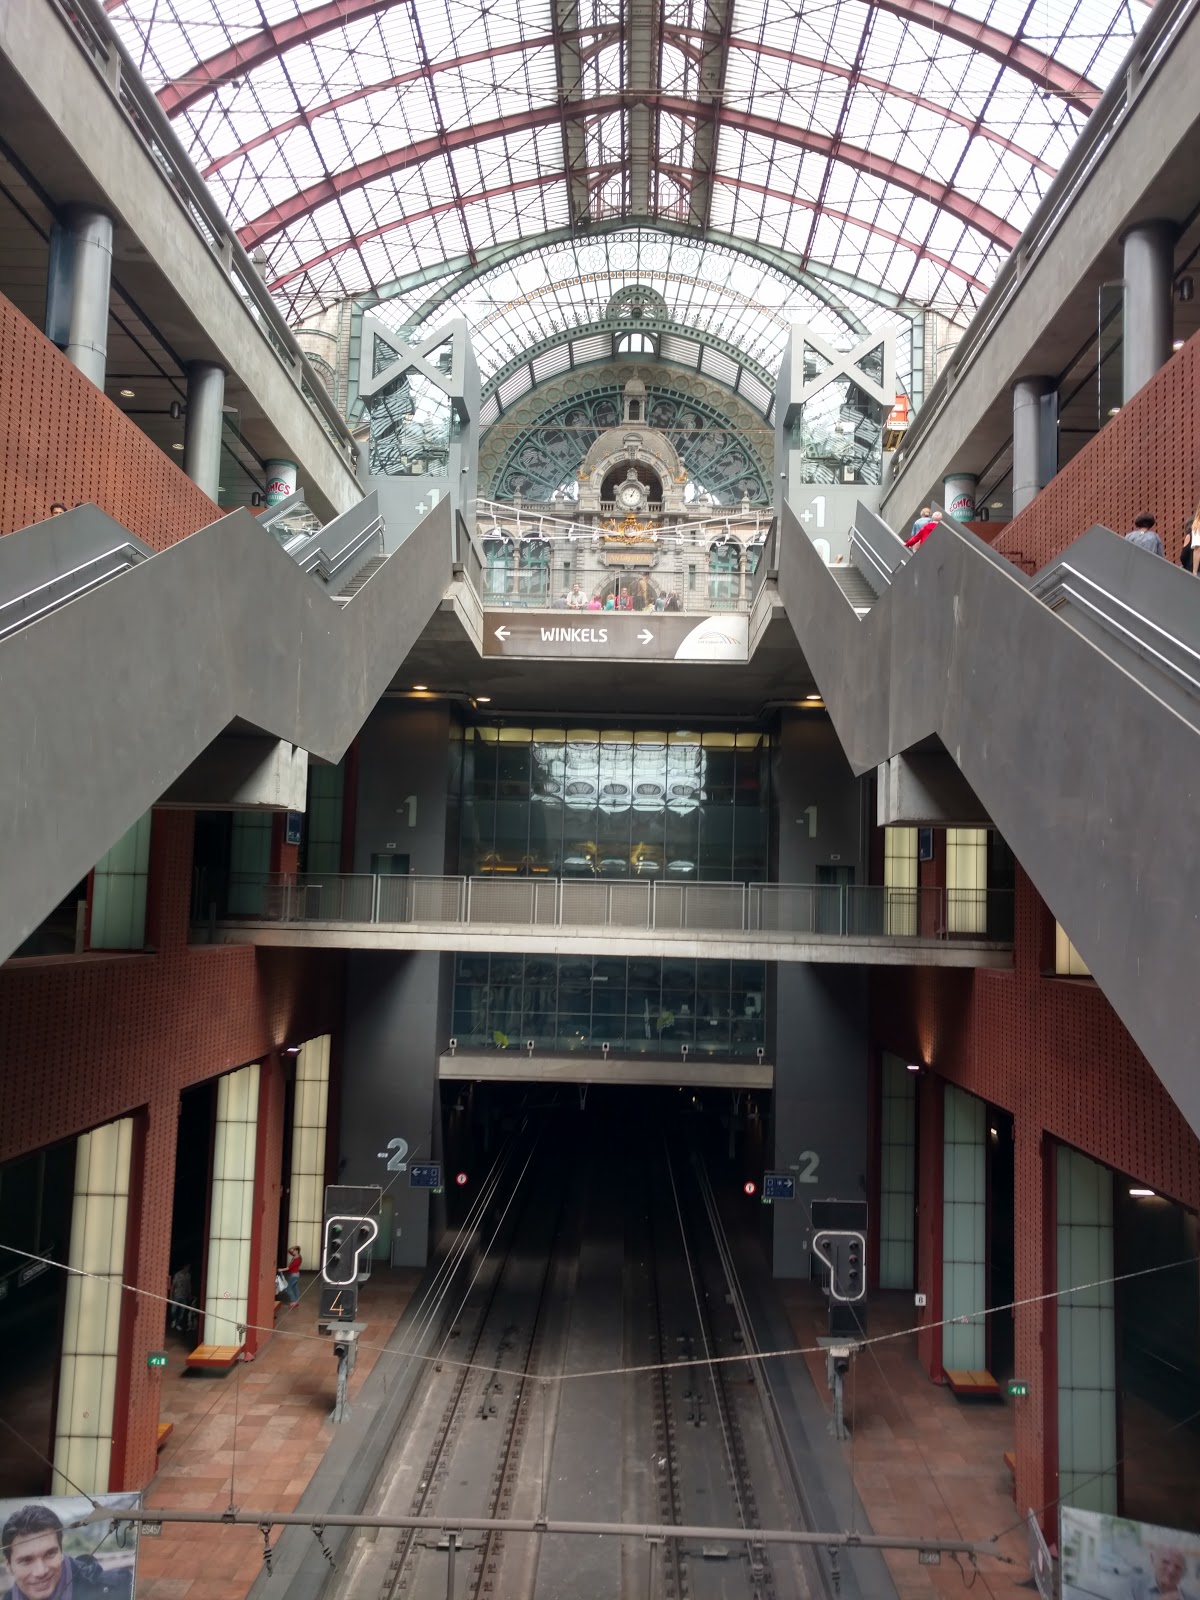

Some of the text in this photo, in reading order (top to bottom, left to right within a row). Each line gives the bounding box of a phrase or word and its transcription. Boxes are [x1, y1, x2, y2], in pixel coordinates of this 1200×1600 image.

[800, 495, 826, 528] +1
[540, 627, 608, 643] WINKELS
[395, 795, 418, 827] -1
[795, 805, 818, 838] -1
[377, 1137, 409, 1171] -2
[789, 1150, 820, 1184] -2
[329, 1290, 345, 1317] 4
